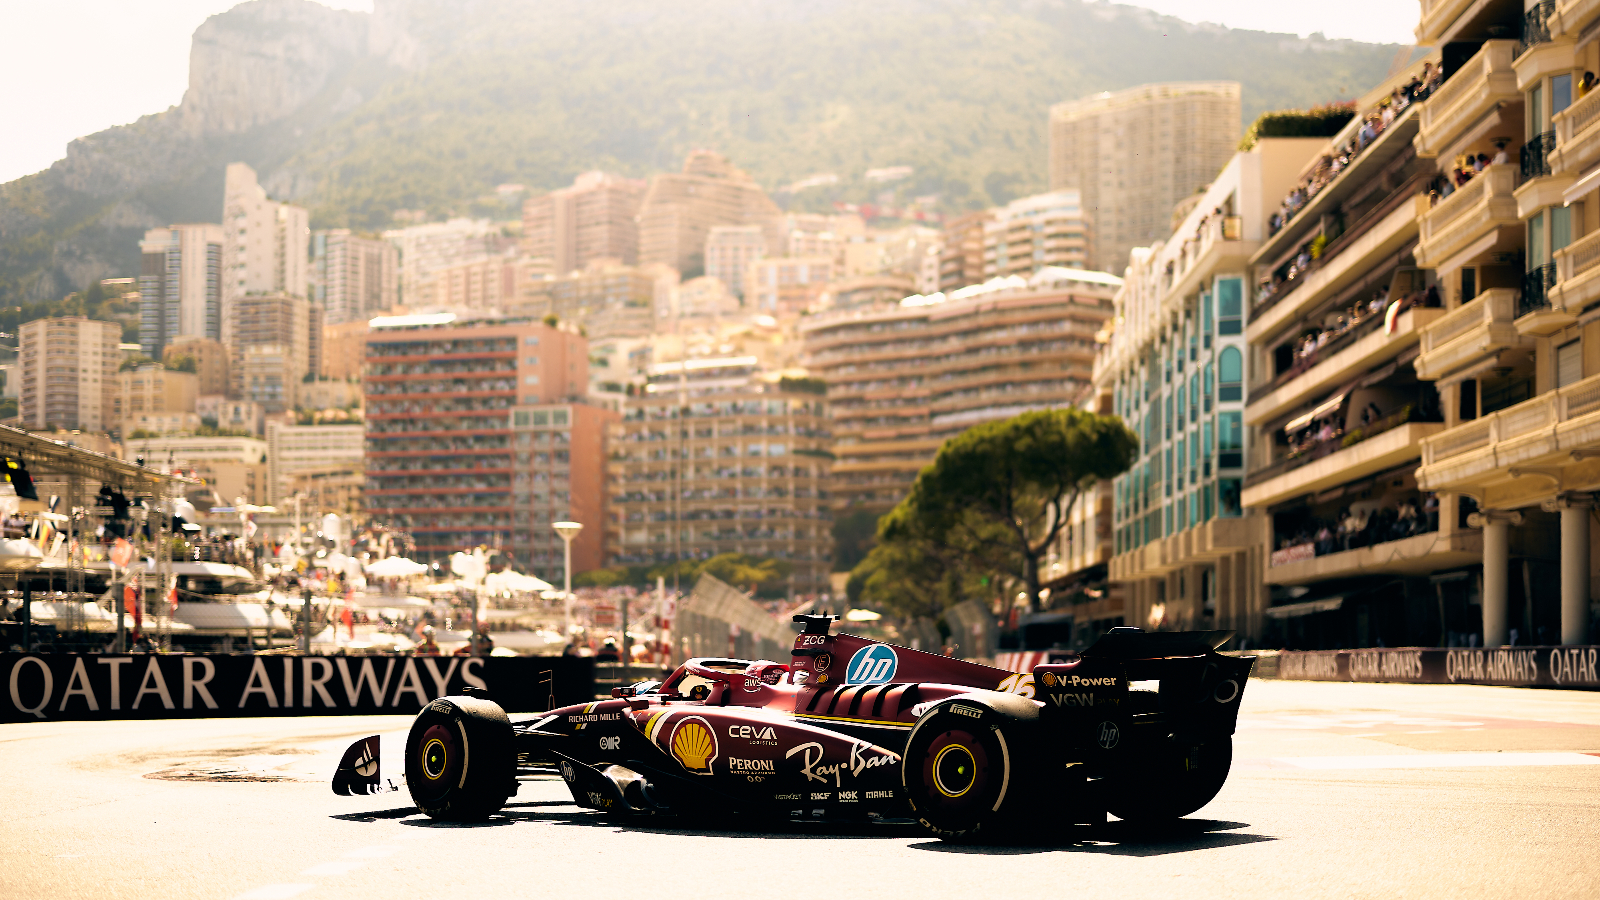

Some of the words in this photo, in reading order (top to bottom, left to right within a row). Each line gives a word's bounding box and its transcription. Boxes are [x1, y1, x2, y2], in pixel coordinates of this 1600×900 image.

[802, 635, 826, 646] ZCG
[850, 643, 894, 685] hp
[1446, 649, 1485, 682] QATAR
[1486, 649, 1538, 681] AIRWAYS
[1549, 648, 1598, 684] QATAR
[8, 656, 220, 718] QATAR
[238, 656, 489, 709] AIRWAYS
[744, 678, 762, 687] aws
[1056, 675, 1117, 687] V-Power
[1049, 692, 1095, 708] VGW
[568, 714, 598, 723] RICHARD
[599, 712, 621, 721] MILLE
[948, 703, 984, 719] PIRELLI
[1099, 722, 1118, 749] hp
[728, 756, 775, 771] PERONI
[838, 790, 859, 800] NGK
[865, 790, 894, 799] MAHLE
